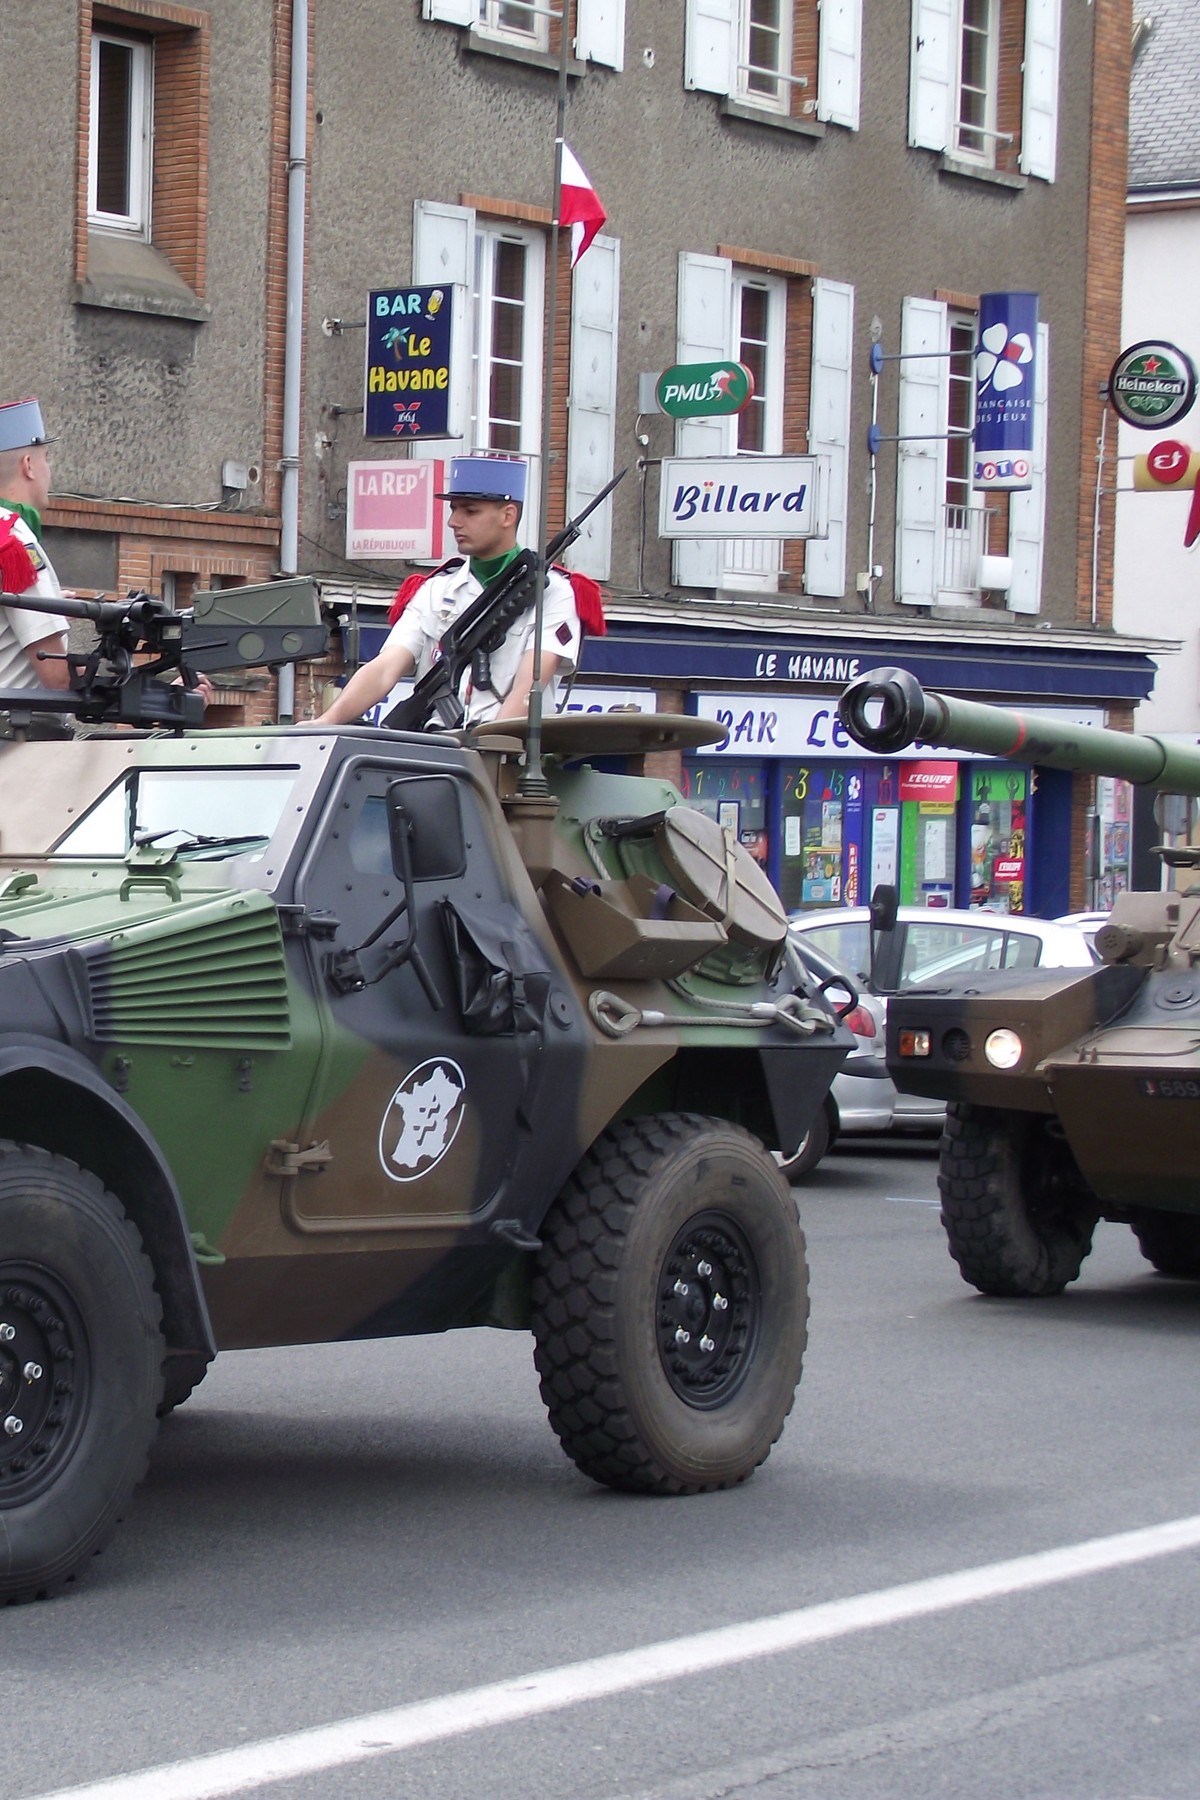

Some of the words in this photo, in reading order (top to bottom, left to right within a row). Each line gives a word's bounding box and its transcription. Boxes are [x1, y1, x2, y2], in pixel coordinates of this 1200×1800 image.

[376, 294, 421, 316] BAR
[408, 334, 431, 356] Le
[369, 366, 448, 393] Havane
[1118, 378, 1181, 393] Heineken
[664, 384, 709, 403] PMU
[397, 412, 416, 423] 1664
[996, 413, 1027, 423] JEUX
[975, 460, 1028, 480] LOTO
[358, 475, 378, 496] LA
[672, 481, 806, 521] Billard
[352, 541, 362, 550] LA
[755, 654, 777, 677] LE
[788, 655, 860, 681] HAVANE
[715, 708, 778, 751] BAR
[794, 768, 810, 799] 3
